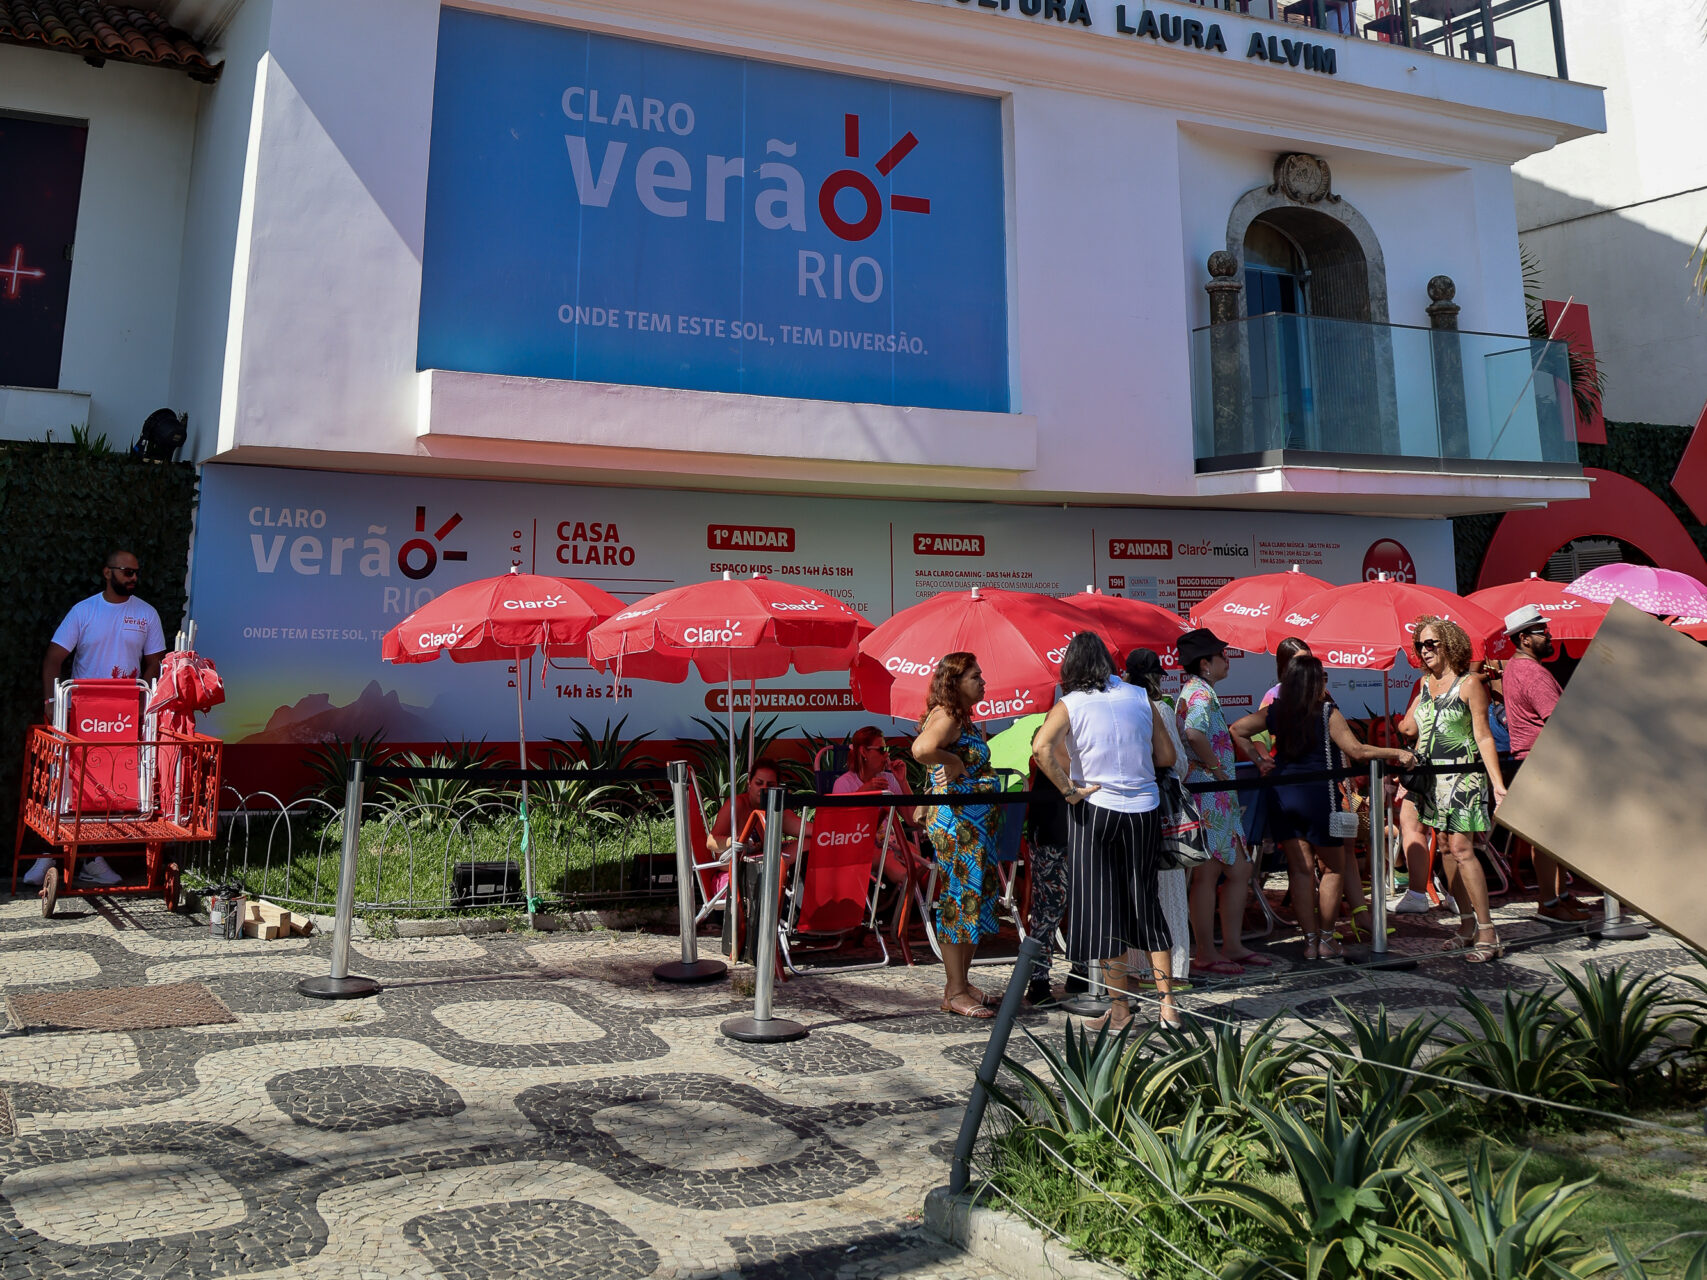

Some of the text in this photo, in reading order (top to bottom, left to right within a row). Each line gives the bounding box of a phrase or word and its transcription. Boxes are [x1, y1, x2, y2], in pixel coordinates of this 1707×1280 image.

[1116, 4, 1227, 53] LAURA
[1246, 32, 1337, 75] ALVIM
[561, 86, 695, 136] CLARO
[563, 134, 888, 242] verão
[798, 249, 884, 304] RIO
[558, 304, 928, 356] ONDE TEM ESTE SOL, TEM DIVERSÃO.
[249, 506, 327, 529] CLARO
[556, 521, 620, 543] CASA
[731, 530, 788, 548] ANDAR
[250, 523, 440, 580] verão
[934, 538, 980, 552] ANDAR
[1127, 543, 1168, 556] ANDAR
[1178, 541, 1249, 557] Claro música
[556, 544, 636, 566] CLARO
[710, 563, 748, 577] ESPAÇO
[750, 564, 773, 574] KIDS
[781, 565, 801, 575] DAS
[803, 566, 820, 575] 14H
[822, 565, 834, 576] ÀS
[836, 567, 853, 576] 18H
[915, 580, 938, 588] ESPAÇO
[1110, 578, 1124, 586] 19H
[1180, 578, 1200, 586] DIOGO
[383, 586, 435, 614] RIO
[503, 596, 562, 609] Claro
[1180, 590, 1202, 598] MARIA
[771, 600, 821, 611] Claro
[858, 602, 868, 611] DE
[1223, 602, 1265, 618] Claro
[1671, 616, 1707, 626] Clar
[243, 627, 389, 642] ONDE TEM ESTE SOL, TE
[418, 628, 460, 648] Claro
[684, 623, 737, 643] Claro
[1327, 647, 1371, 665] Claro
[885, 656, 934, 676] Claro
[1388, 676, 1411, 688] Claro
[556, 685, 633, 698] 14h às 22h
[975, 695, 1028, 716] Claro
[80, 715, 128, 733] Claro
[817, 826, 865, 847] Claro
